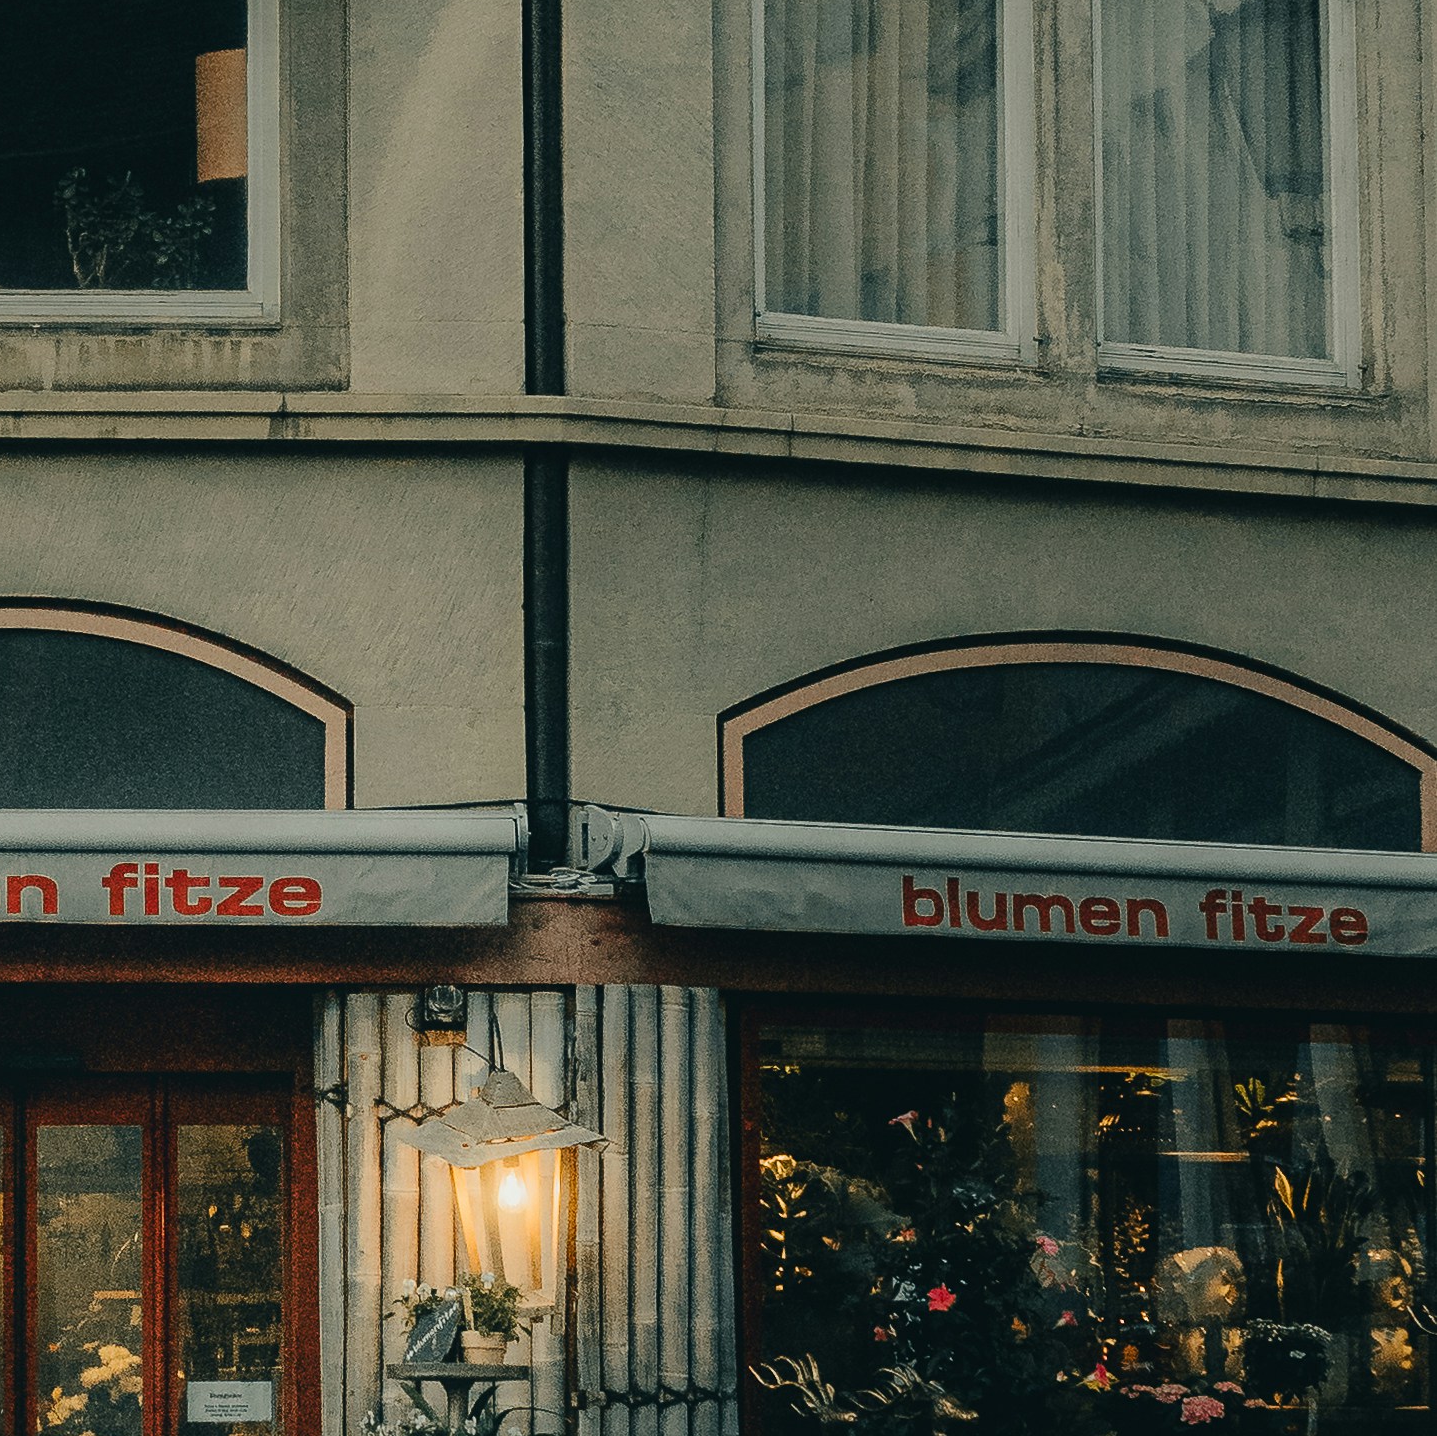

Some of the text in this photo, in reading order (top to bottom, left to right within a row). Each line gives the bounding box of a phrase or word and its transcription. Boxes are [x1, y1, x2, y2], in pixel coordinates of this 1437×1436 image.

[101, 861, 323, 918] fitze
[901, 874, 1369, 947] blumen fitze
